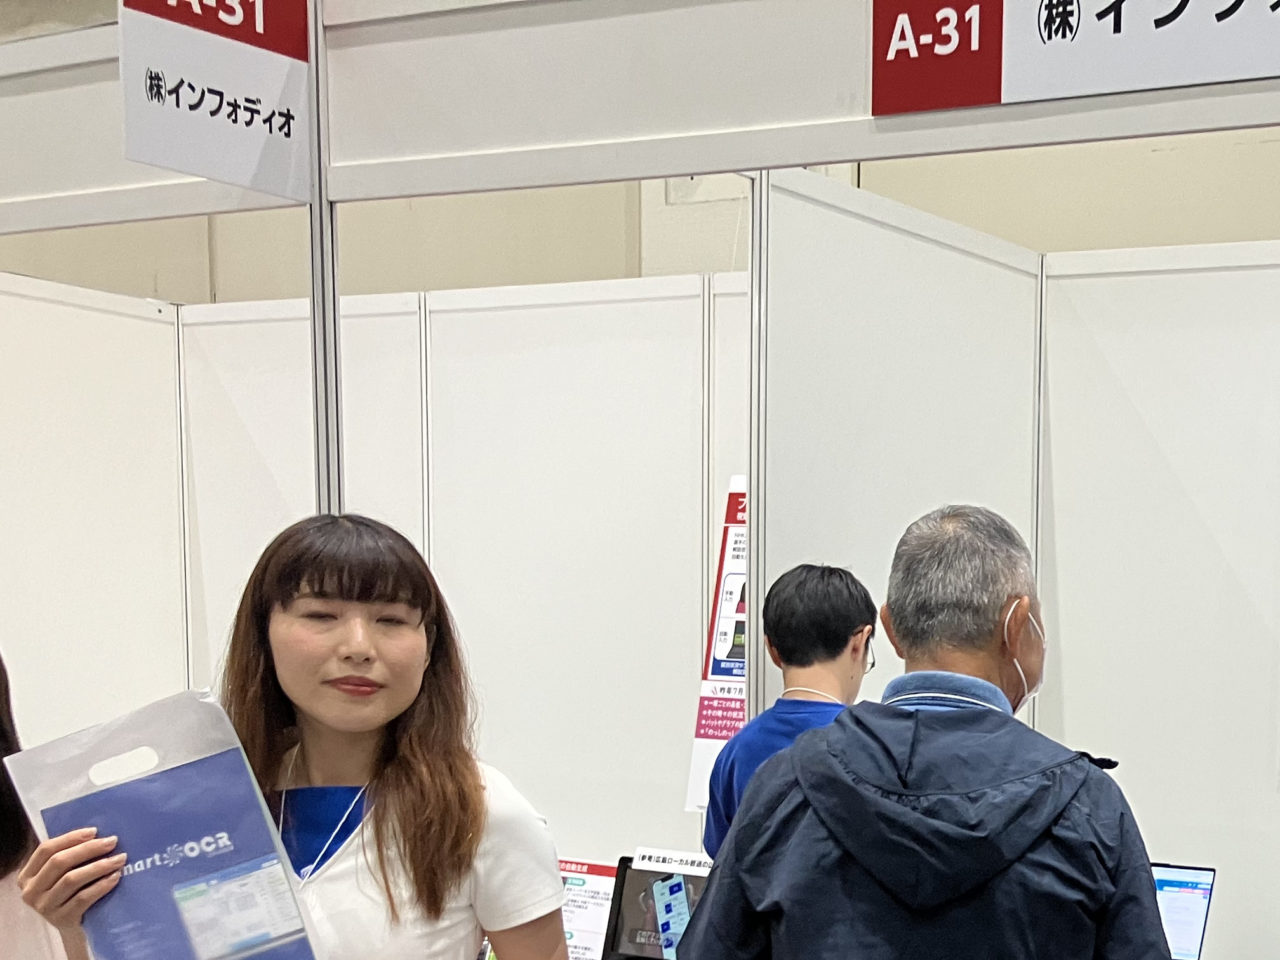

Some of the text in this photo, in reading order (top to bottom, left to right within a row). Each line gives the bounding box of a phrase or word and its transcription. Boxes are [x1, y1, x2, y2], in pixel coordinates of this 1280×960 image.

[886, 4, 981, 61] A-31
[119, 853, 162, 878] mart
[183, 831, 232, 858] OCR
